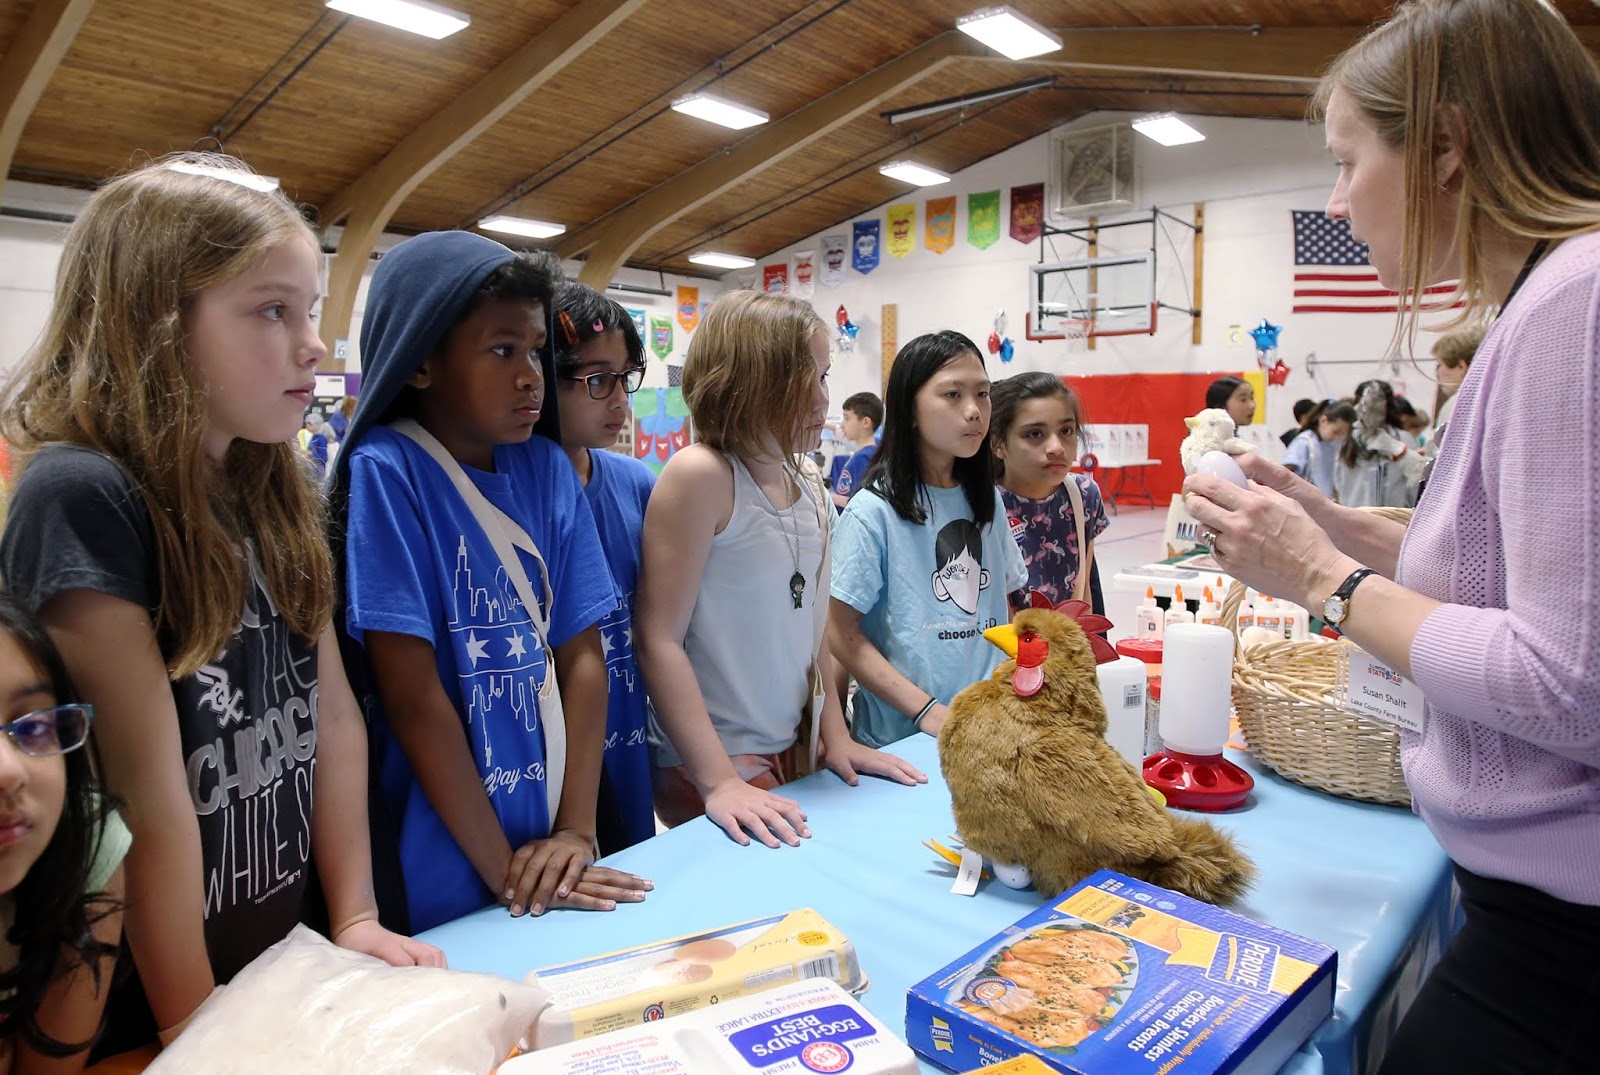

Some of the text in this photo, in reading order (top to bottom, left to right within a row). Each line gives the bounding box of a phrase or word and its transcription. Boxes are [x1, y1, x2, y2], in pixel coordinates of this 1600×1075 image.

[938, 630, 976, 640] choose
[1368, 668, 1386, 679] STATE
[1363, 686, 1407, 709] Susan Shalit
[1351, 698, 1418, 728] Lake County Farm Bureau
[187, 686, 318, 815] CHICAG
[203, 779, 289, 921] WHITE
[1231, 941, 1270, 986] PERDUE
[715, 1016, 749, 1033] LARGE
[748, 1007, 781, 1023] EXTRA
[768, 1012, 822, 1036] BEST
[1124, 989, 1205, 1051] Chicken Breasts
[1141, 995, 1226, 1062] Boneless Skinless
[931, 1027, 952, 1037] PERDUE
[1175, 1027, 1214, 1058] Individually
[590, 1052, 620, 1065] Regular
[760, 1037, 880, 1075] FARM FRESH
